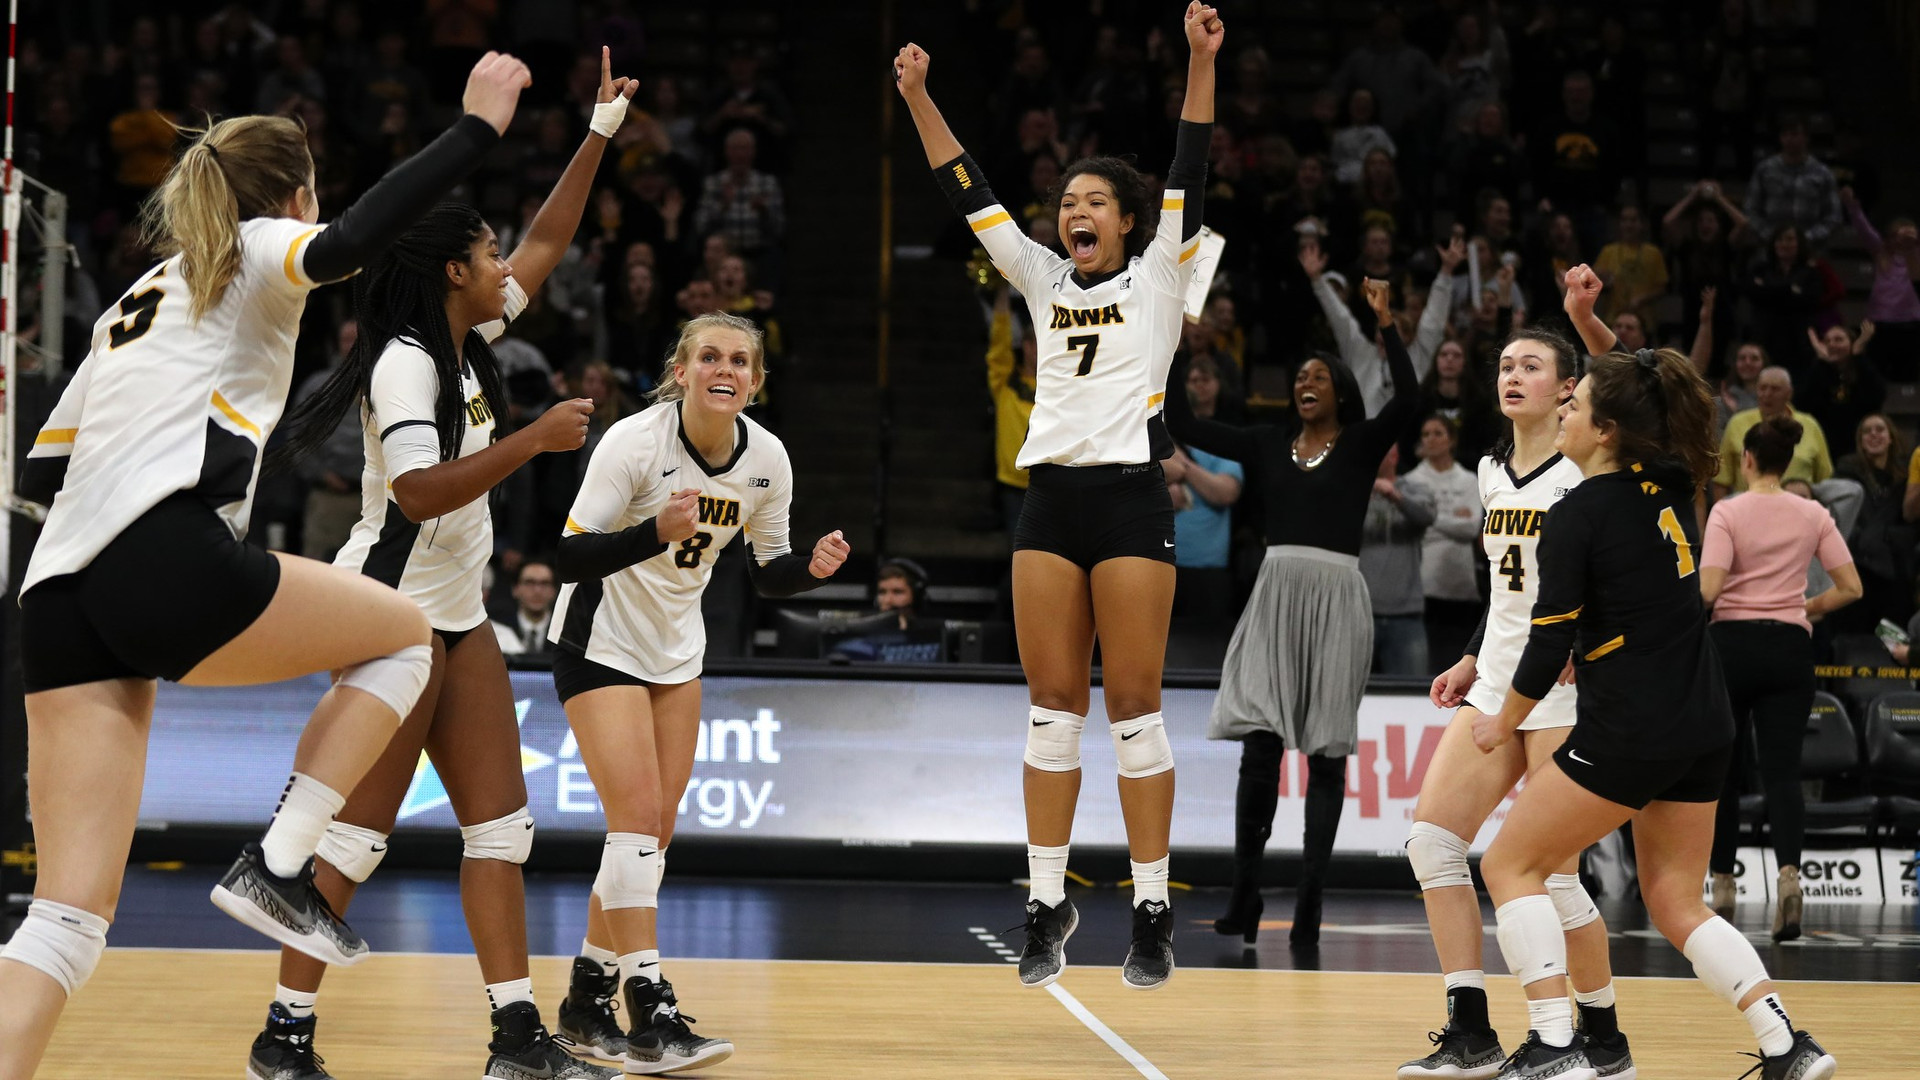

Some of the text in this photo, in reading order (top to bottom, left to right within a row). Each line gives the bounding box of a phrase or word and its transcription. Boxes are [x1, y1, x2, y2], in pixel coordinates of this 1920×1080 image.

[109, 263, 166, 351] 5
[1049, 302, 1125, 330] IOWA
[1067, 333, 1100, 377] 7
[1484, 508, 1547, 537] IOWA
[1657, 506, 1696, 579] 1
[674, 531, 713, 569] 8
[1499, 544, 1525, 592] 4
[557, 762, 774, 828] Ergy
[1798, 860, 1861, 880] ero
[1800, 883, 1862, 897] talities
